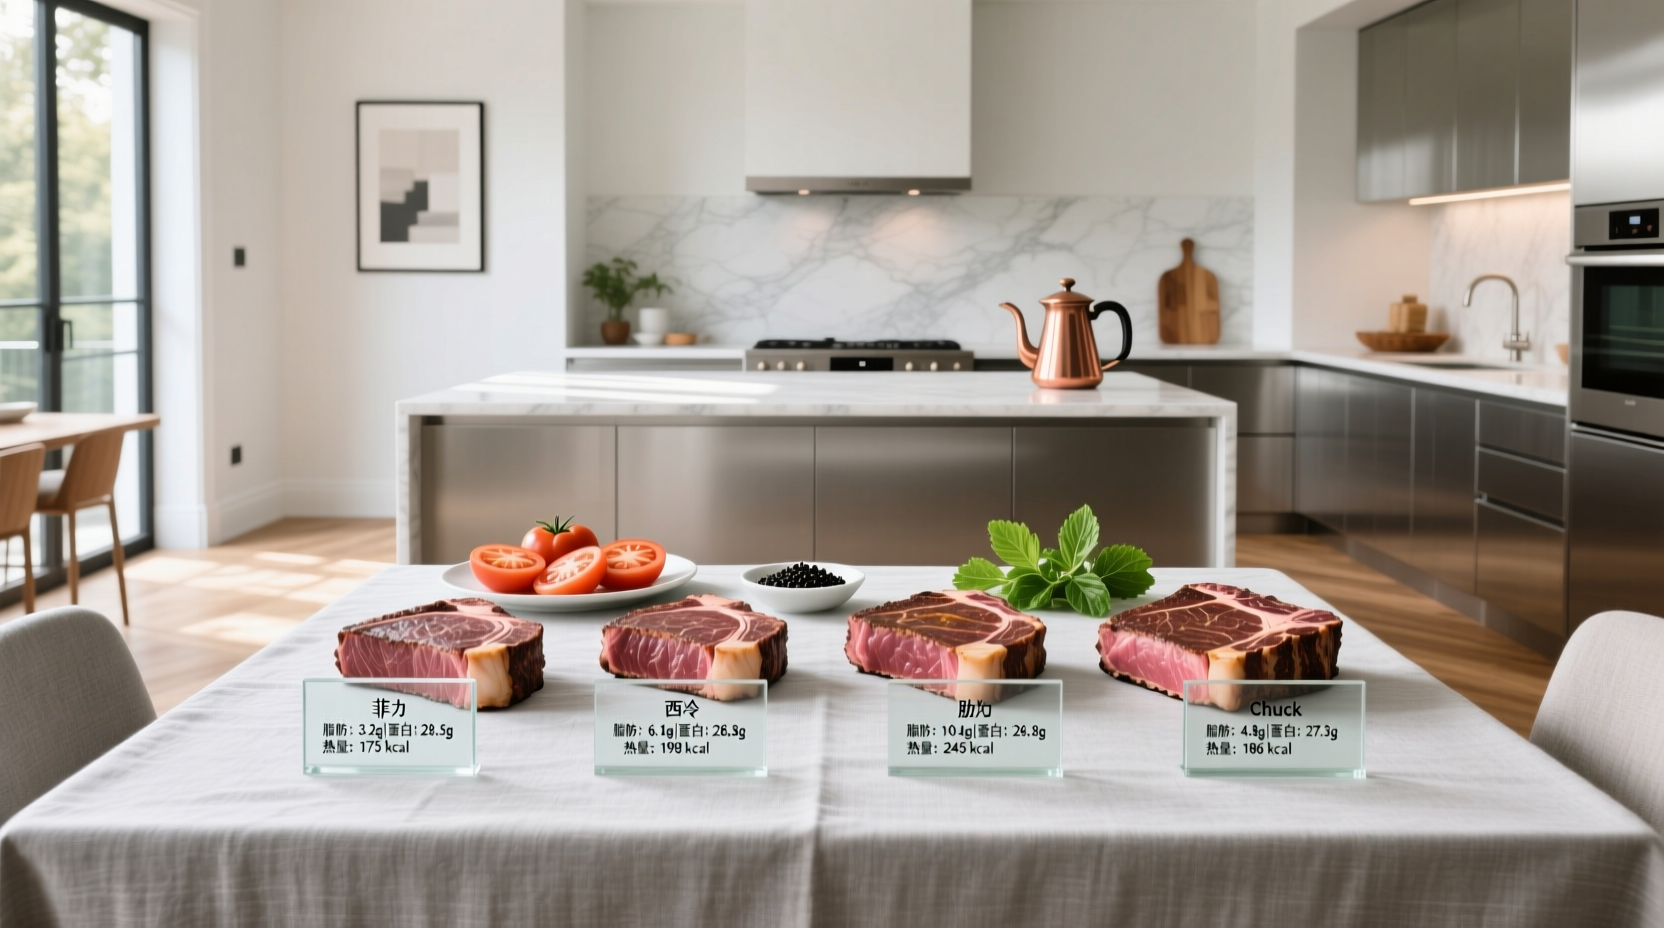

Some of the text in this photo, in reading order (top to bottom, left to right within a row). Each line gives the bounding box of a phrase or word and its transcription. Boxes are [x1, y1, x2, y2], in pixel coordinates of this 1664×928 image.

[371, 697, 406, 719] 菲力
[1250, 700, 1302, 717] Chuck
[360, 740, 382, 753] 175
[385, 740, 410, 753] kcal
[685, 741, 710, 754] kcal
[943, 742, 967, 754] 245
[969, 741, 994, 754] kcal
[1267, 741, 1292, 755] kcal
